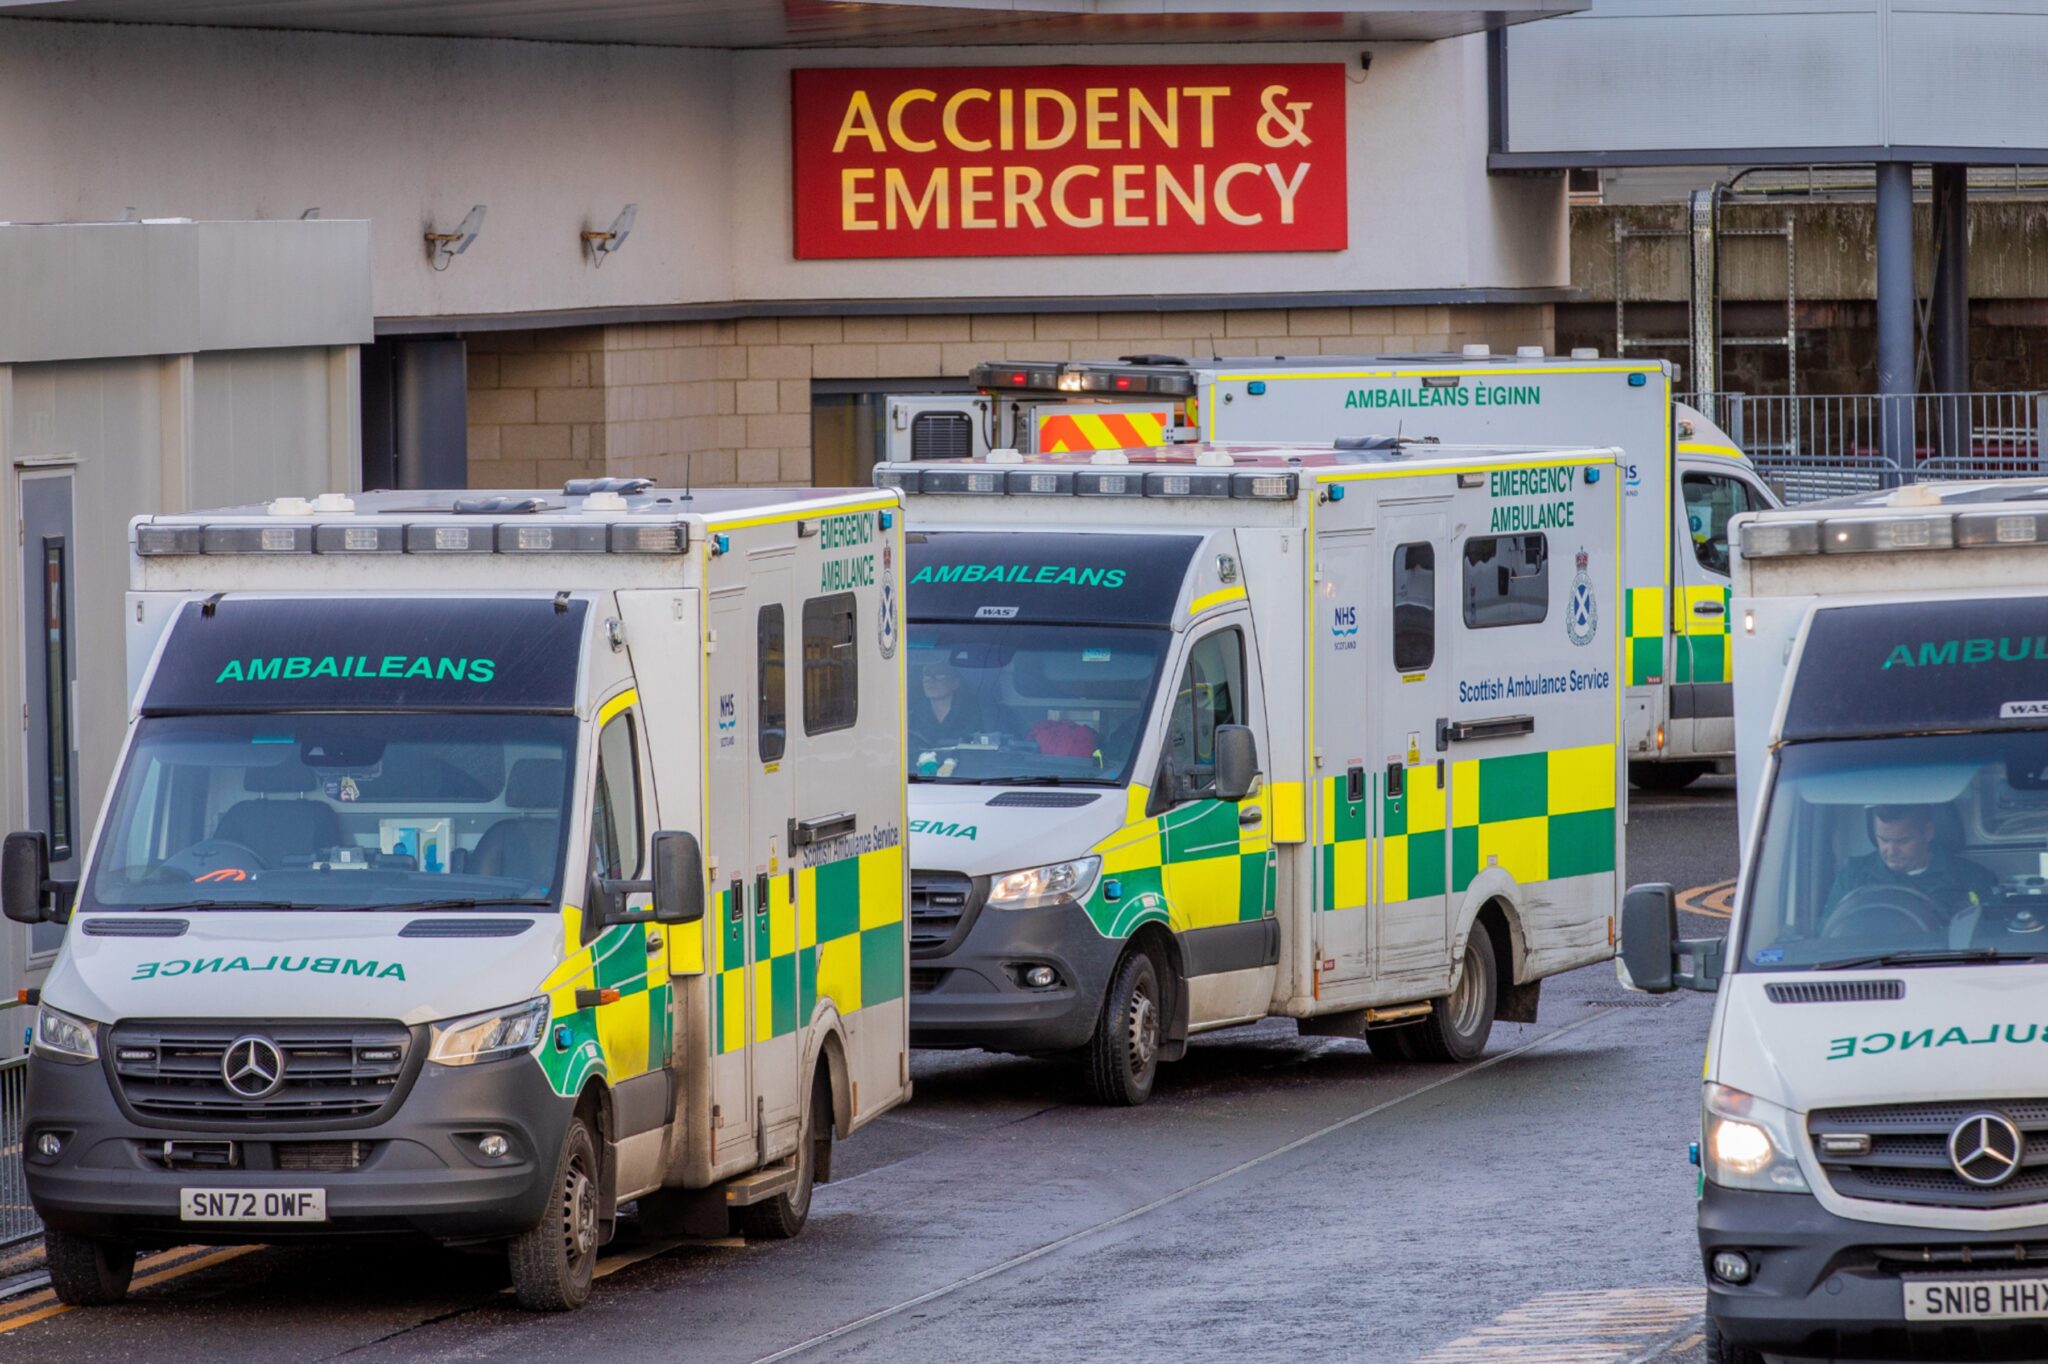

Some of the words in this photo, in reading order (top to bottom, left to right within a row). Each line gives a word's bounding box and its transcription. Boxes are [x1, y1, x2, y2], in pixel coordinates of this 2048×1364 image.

[832, 86, 1231, 152] ACCIDENT
[1256, 85, 1313, 148] &
[841, 162, 1311, 231] EMERGENCY
[1344, 386, 1469, 409] AMBAILEANS
[1475, 381, 1541, 405] ÈIGINN
[1490, 466, 1575, 498] EMERGENCY
[820, 512, 874, 550] EMERGENCY
[1490, 501, 1575, 533] AMBULANCE
[821, 554, 875, 593] AMBULANCE
[910, 564, 1127, 588] AMBAILEANS
[982, 608, 1011, 616] WAS
[1334, 606, 1356, 626] NHS
[216, 655, 496, 684] AMBAILEANS
[1459, 678, 1504, 703] Scottish
[1506, 673, 1567, 698] Ambulance
[1569, 668, 1609, 692] Service
[720, 693, 734, 717] NHS
[2010, 704, 2048, 714] WAS
[873, 822, 899, 851] Service
[193, 1193, 257, 1217] SN72
[264, 1193, 313, 1217] OWF
[1926, 1286, 1991, 1314] SN18
